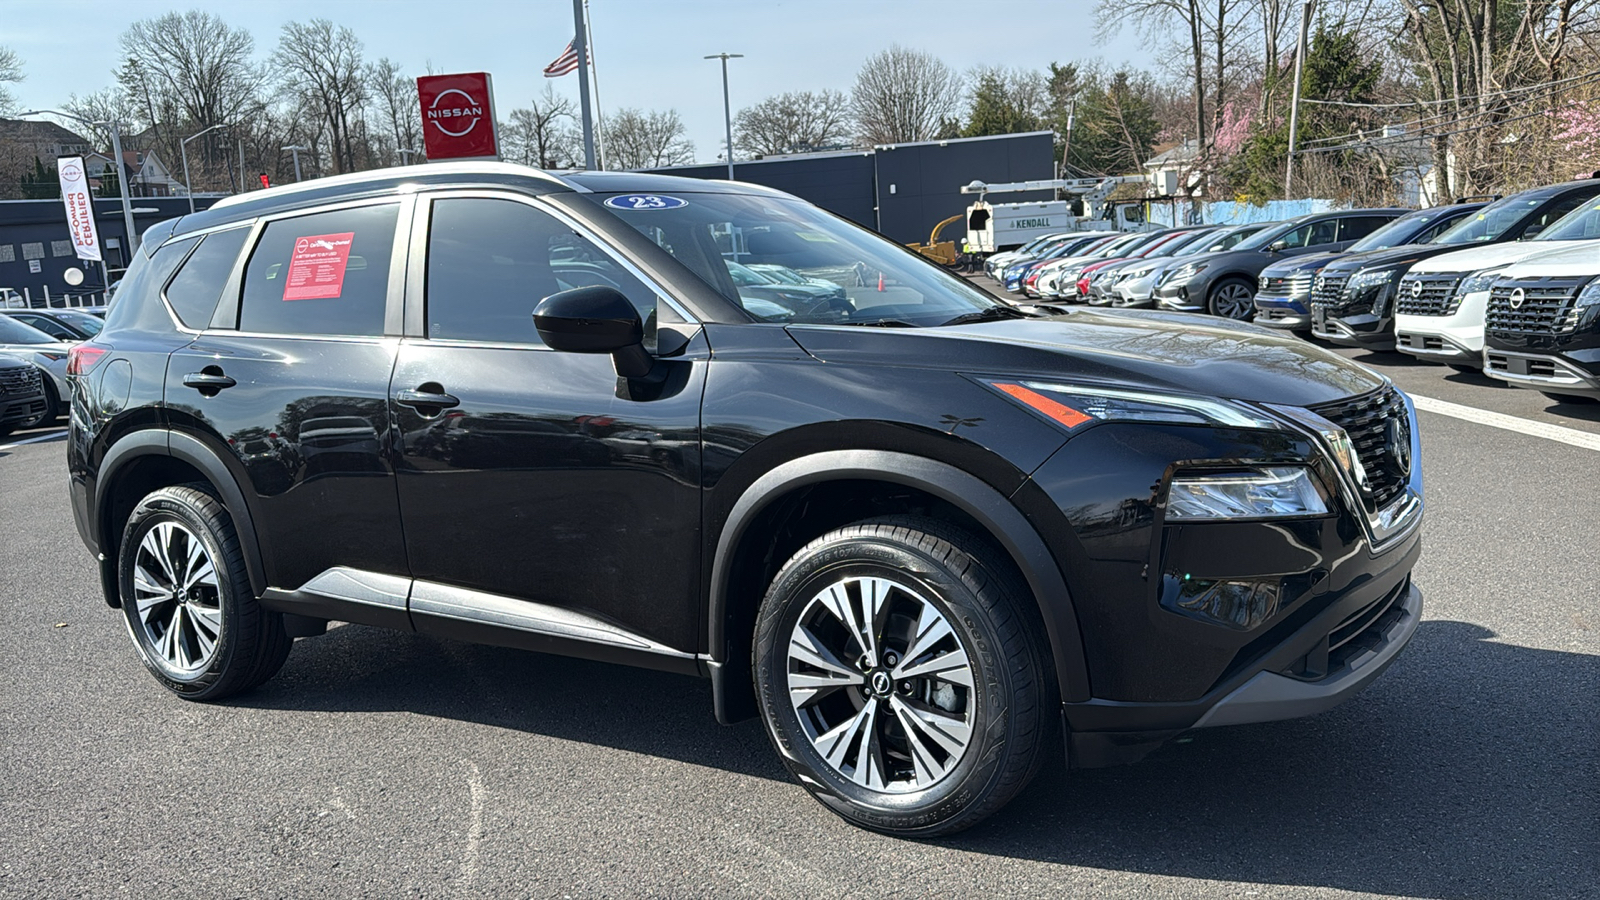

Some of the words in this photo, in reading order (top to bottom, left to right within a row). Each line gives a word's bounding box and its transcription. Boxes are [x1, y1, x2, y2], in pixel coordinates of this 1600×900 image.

[427, 107, 482, 119] NISSAN
[628, 196, 666, 208] 23
[1016, 217, 1051, 229] KENDALL
